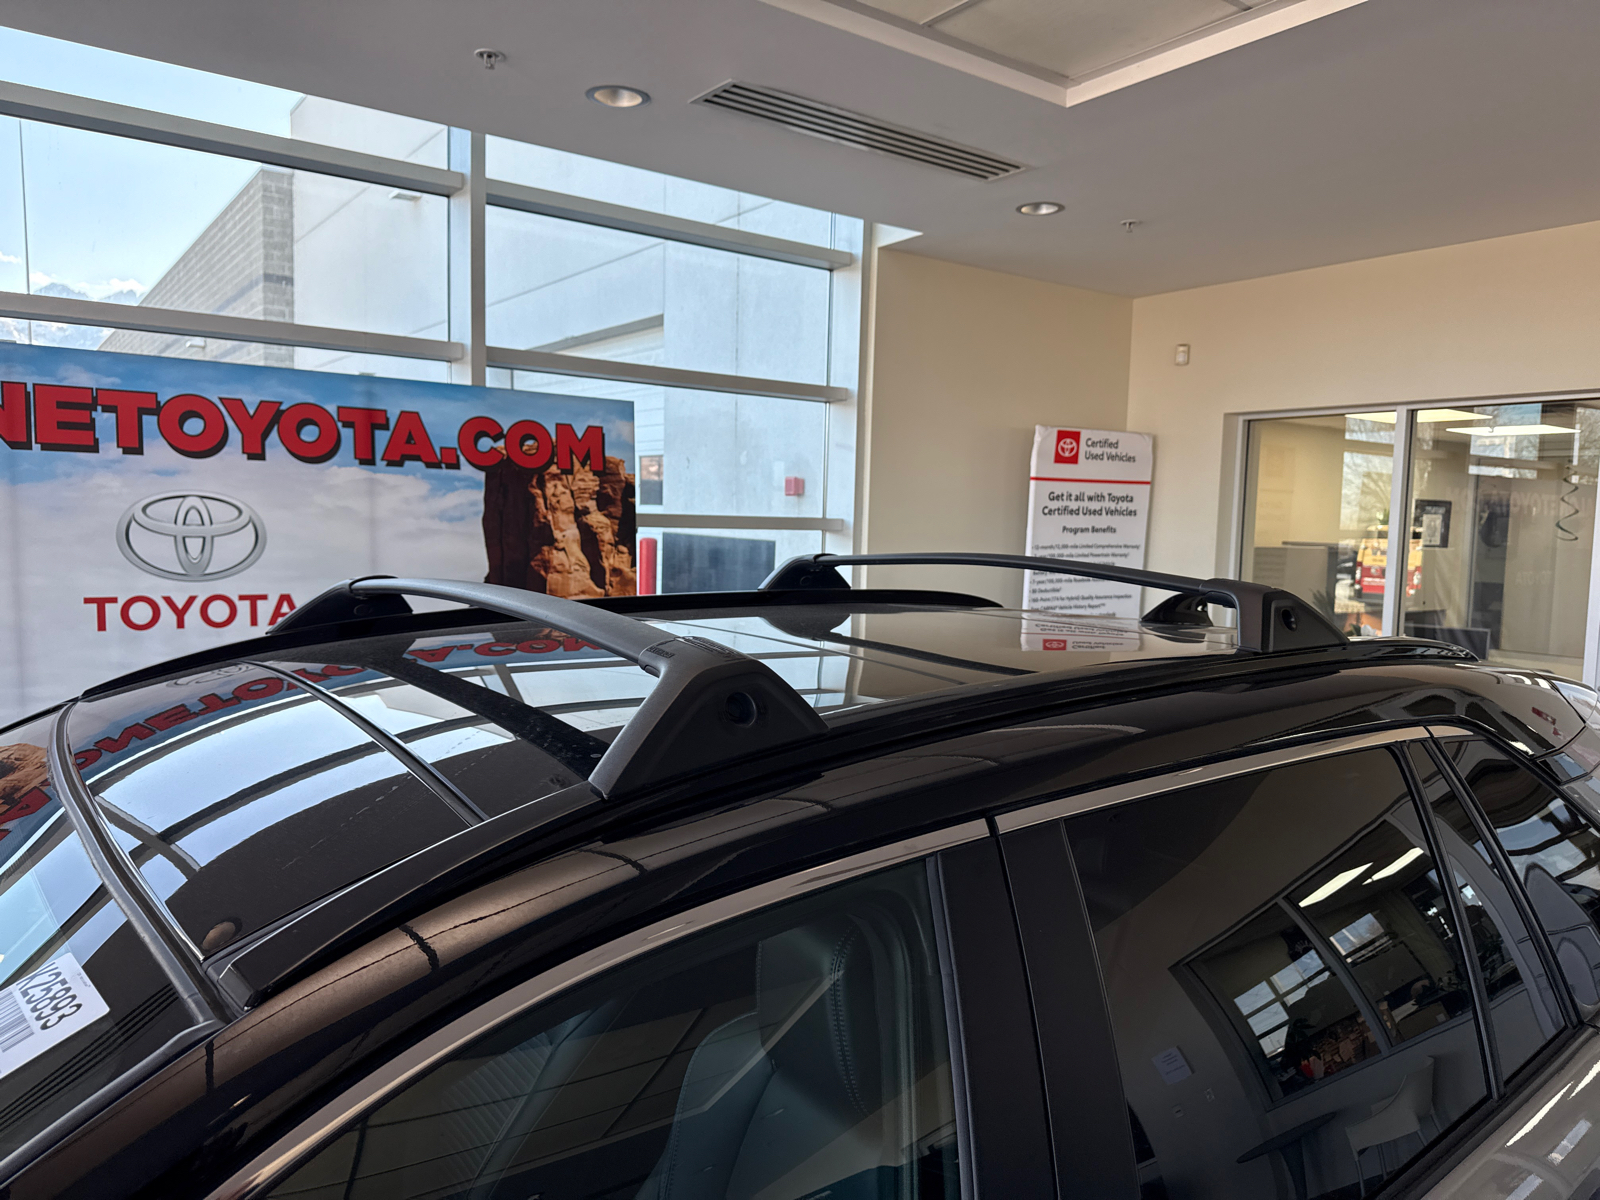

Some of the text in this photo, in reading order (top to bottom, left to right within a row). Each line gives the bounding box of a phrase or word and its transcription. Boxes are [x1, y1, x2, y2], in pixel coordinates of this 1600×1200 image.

[1085, 438, 1119, 449] Certified
[1084, 450, 1136, 463] Used Vehicles
[1048, 491, 1134, 505] Get it all with Toyota
[1042, 505, 1137, 517] Certified Used Vehicles
[1062, 525, 1116, 535] Program Benefits
[83, 593, 299, 632] TOYOTA
[15, 961, 83, 1031] K25893
